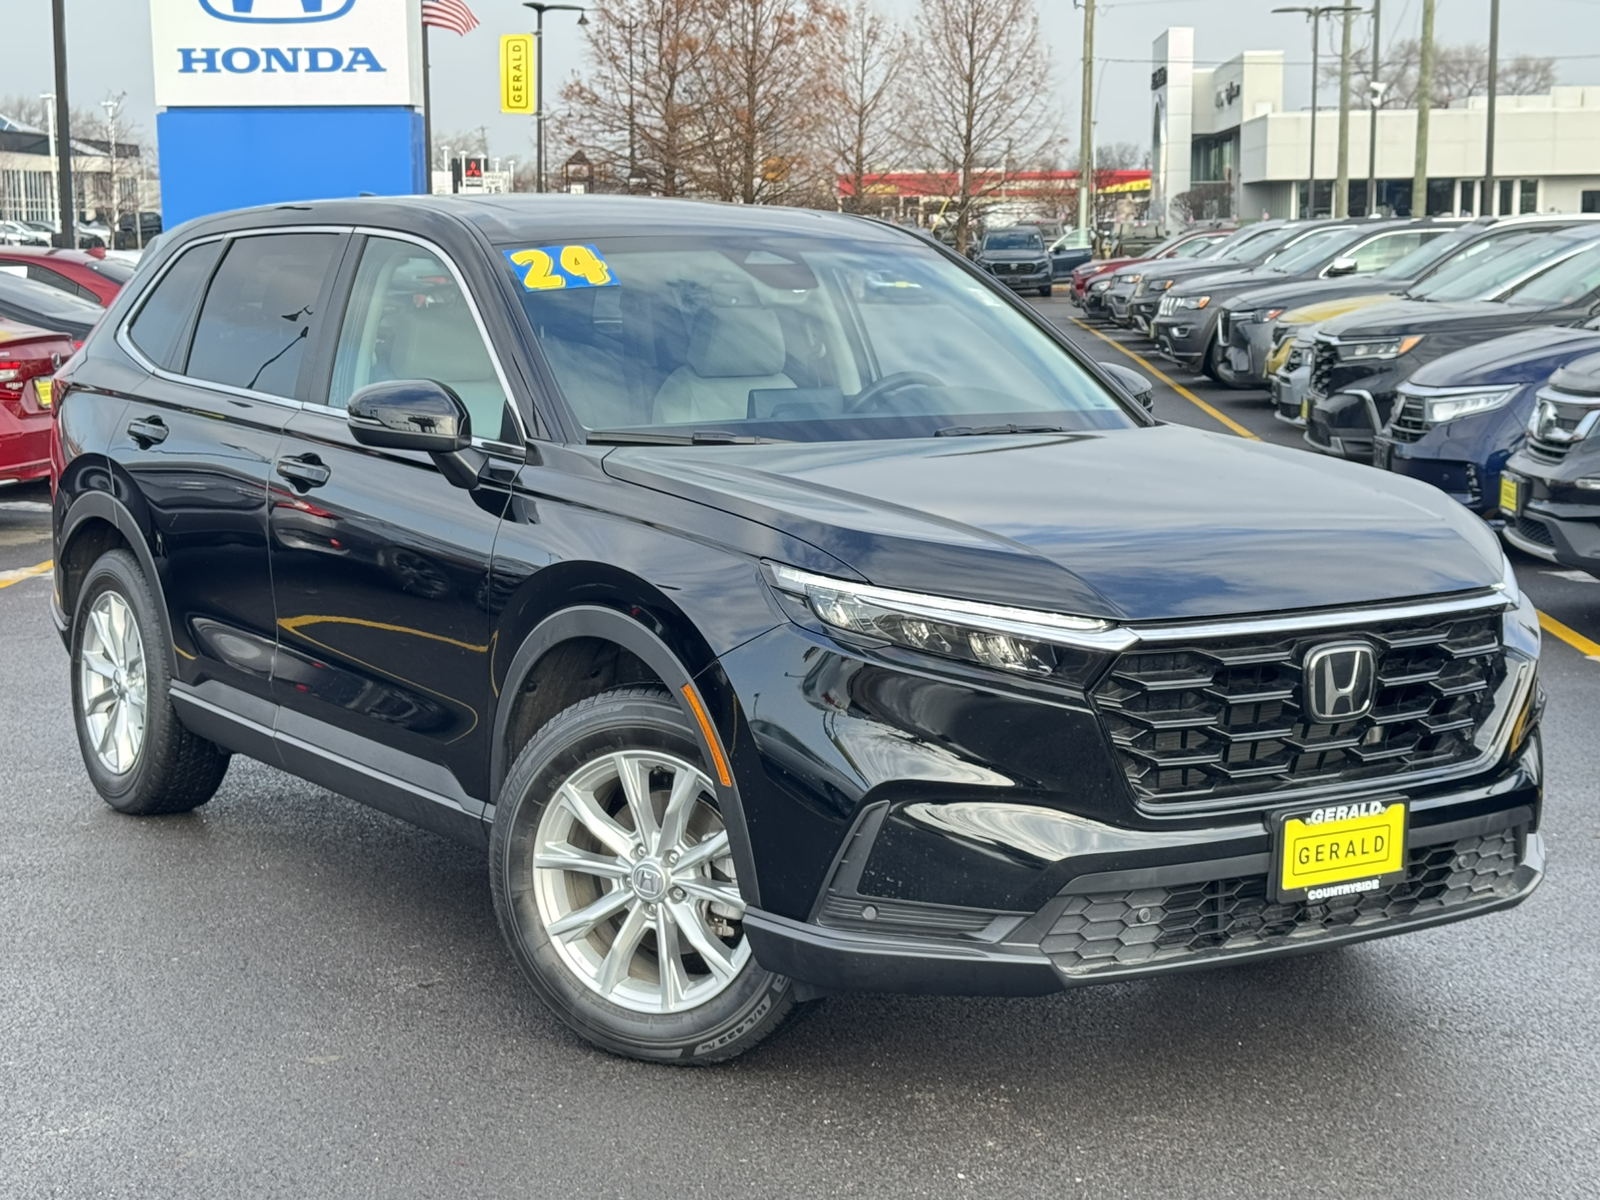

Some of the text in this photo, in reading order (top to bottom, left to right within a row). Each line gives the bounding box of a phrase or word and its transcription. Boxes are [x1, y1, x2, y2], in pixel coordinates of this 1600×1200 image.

[177, 47, 387, 74] HONDA
[512, 44, 523, 103] GERALD
[510, 245, 611, 290] 24
[1311, 801, 1382, 825] GERALD
[1298, 835, 1385, 865] GERALD
[1307, 879, 1380, 900] COUNTRYSIDE
